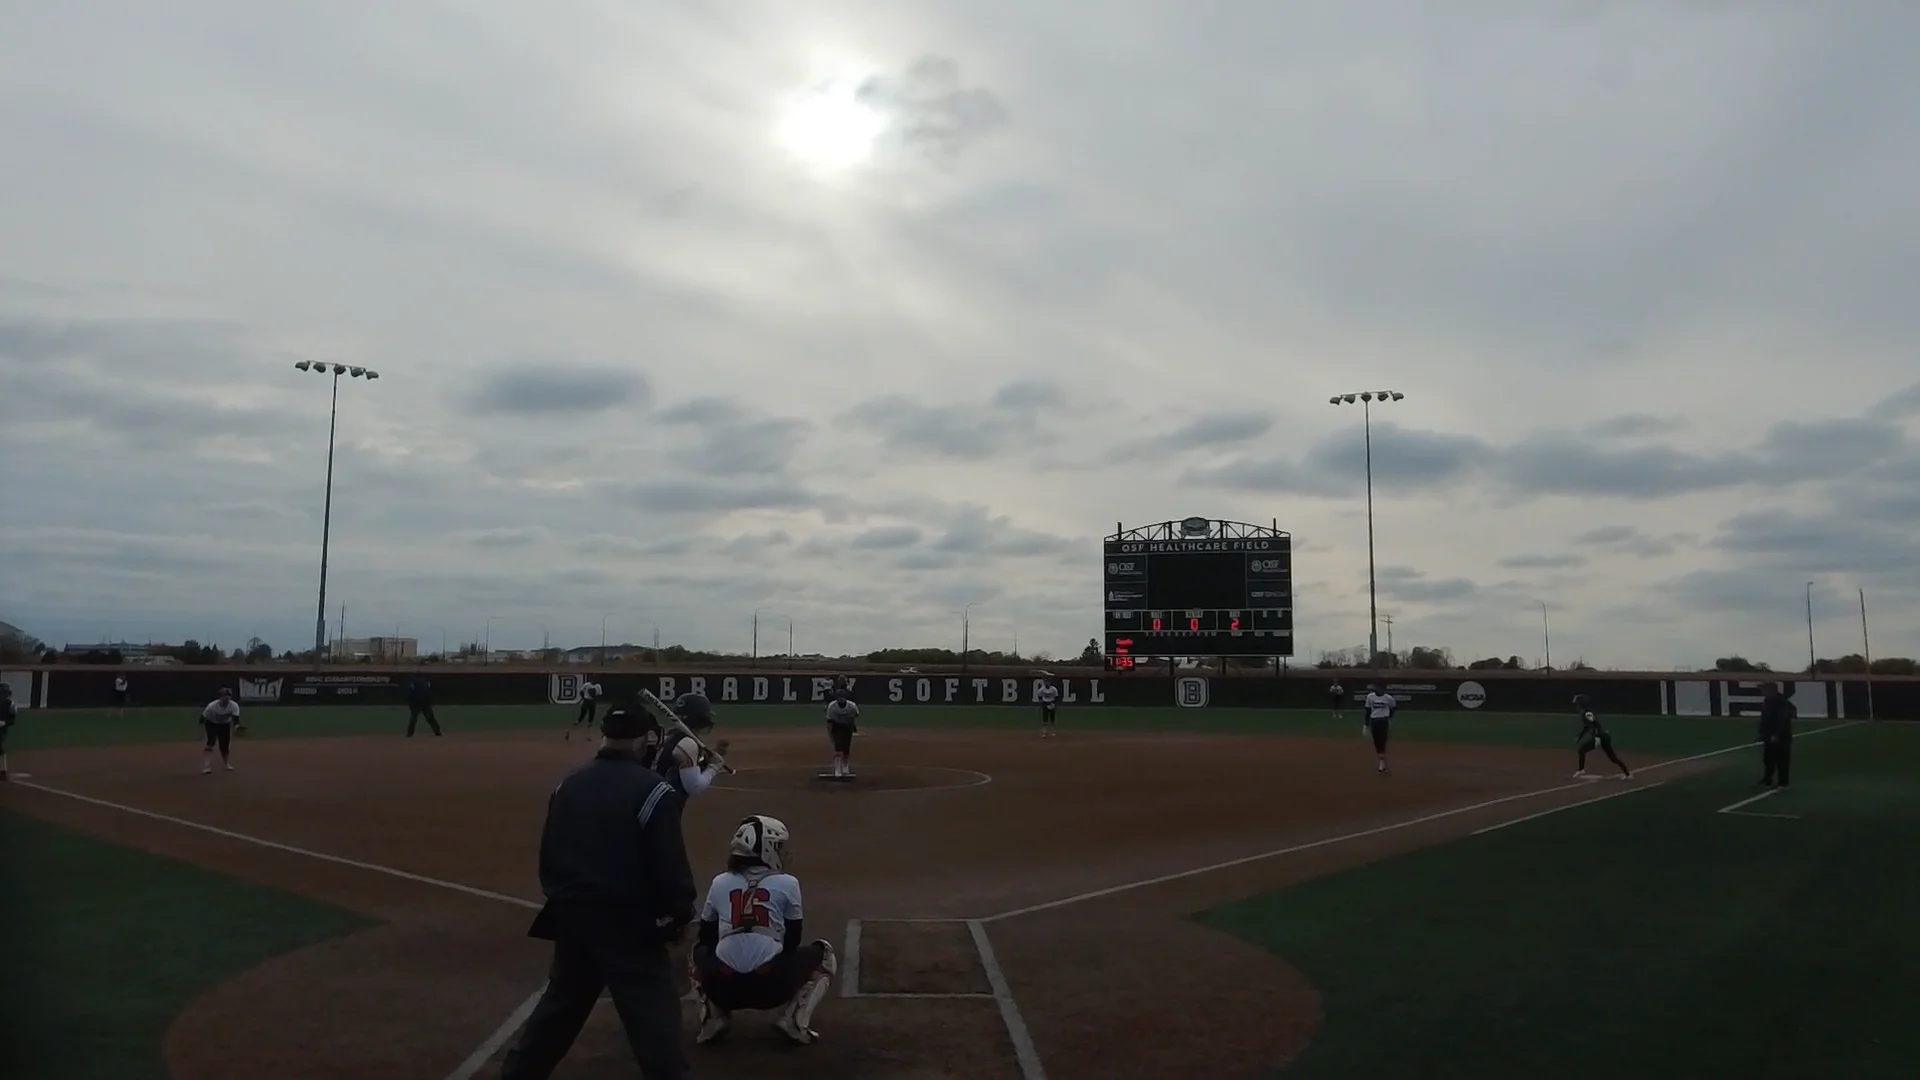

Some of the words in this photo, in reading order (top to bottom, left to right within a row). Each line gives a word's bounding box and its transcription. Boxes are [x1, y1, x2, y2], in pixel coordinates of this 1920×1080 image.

[1121, 544, 1145, 553] OSF
[1149, 541, 1229, 553] HEALTHCARE
[1233, 540, 1270, 551] FIELD
[1153, 618, 1162, 631] 0
[1230, 618, 1240, 631] 2
[888, 678, 1106, 703] SOFTBALL
[1180, 678, 1206, 706] B
[729, 887, 770, 930] 16
